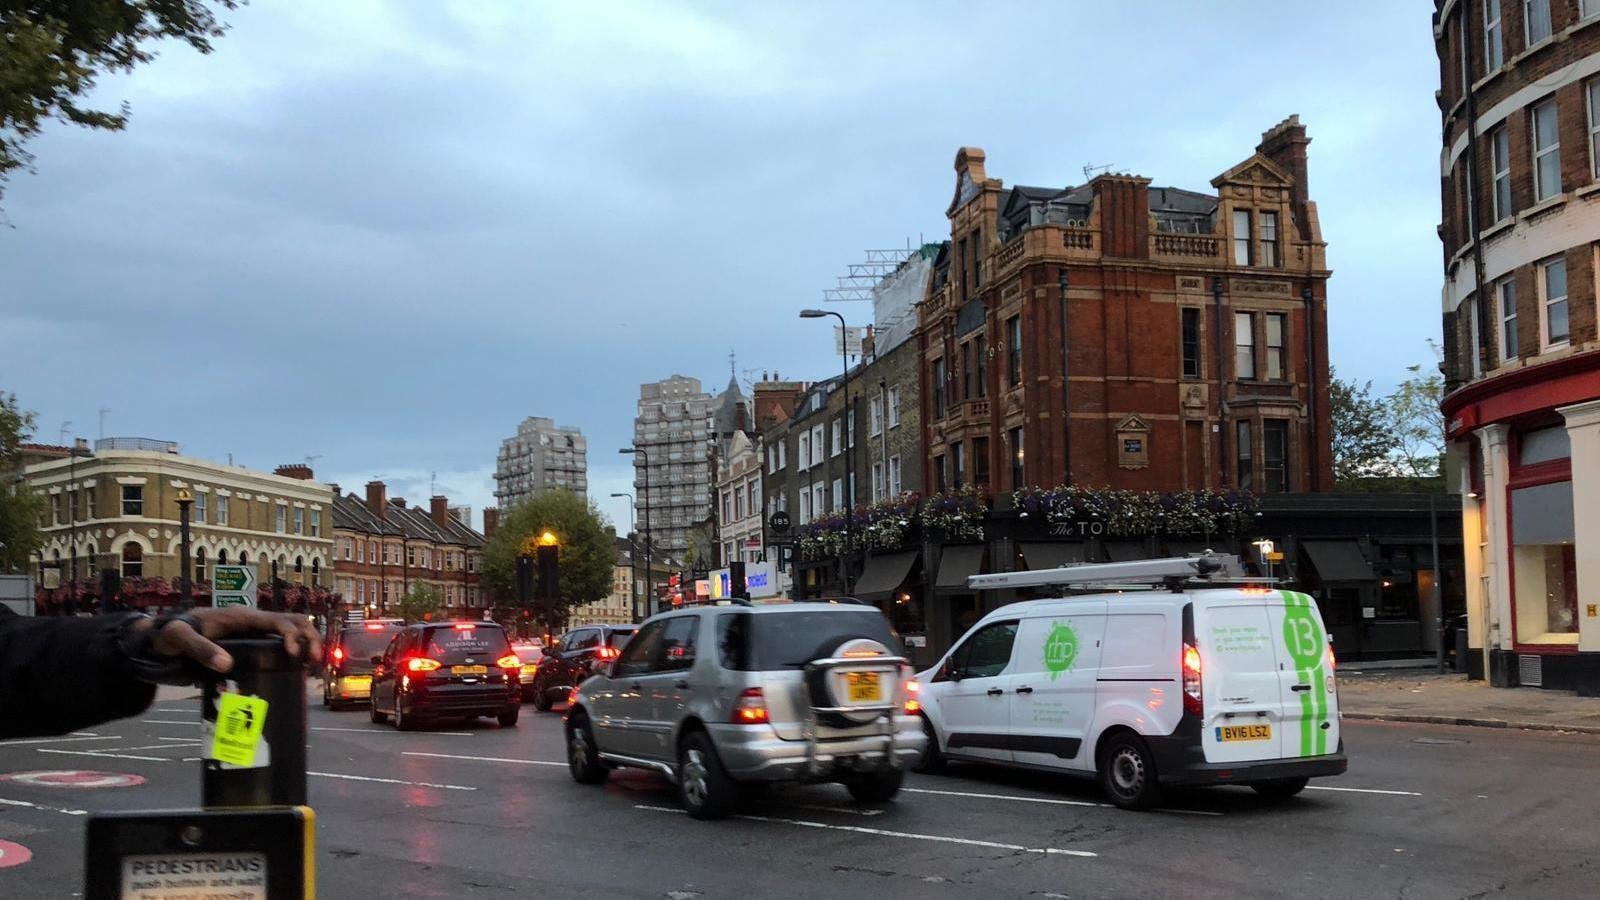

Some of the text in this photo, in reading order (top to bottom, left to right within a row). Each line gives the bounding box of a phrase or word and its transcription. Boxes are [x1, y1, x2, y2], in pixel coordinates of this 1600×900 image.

[1049, 521, 1073, 536] The
[1288, 617, 1317, 656] 13
[1225, 725, 1268, 739] BV16 LSZ
[132, 857, 261, 875] PEDESTRIANS
